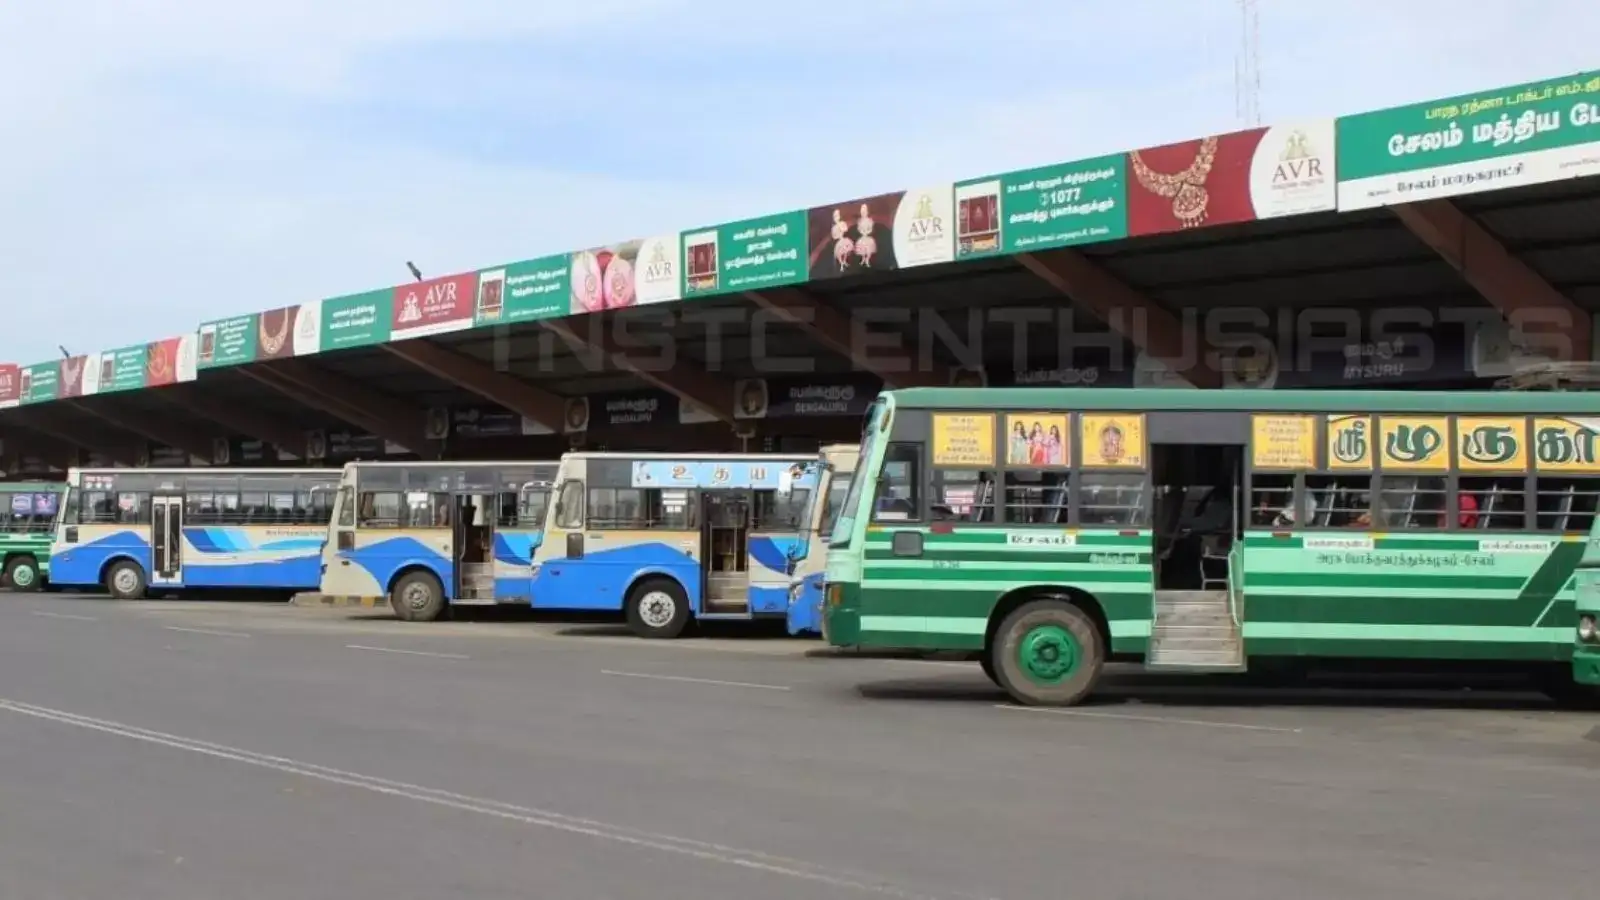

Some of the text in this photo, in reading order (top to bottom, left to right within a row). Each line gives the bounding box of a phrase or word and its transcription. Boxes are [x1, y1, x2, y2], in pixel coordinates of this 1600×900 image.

[1387, 121, 1464, 157] சேலம்
[1472, 109, 1561, 147] மத்திய
[1271, 157, 1324, 184] AVR
[1397, 174, 1437, 193] சேலம்
[1050, 187, 1081, 204] 1077
[908, 216, 944, 238] AVR
[645, 261, 672, 281] AVR
[423, 282, 457, 305] AVR
[1343, 363, 1405, 380] MYSURU
[1333, 420, 1367, 464] ஸ்ரீ
